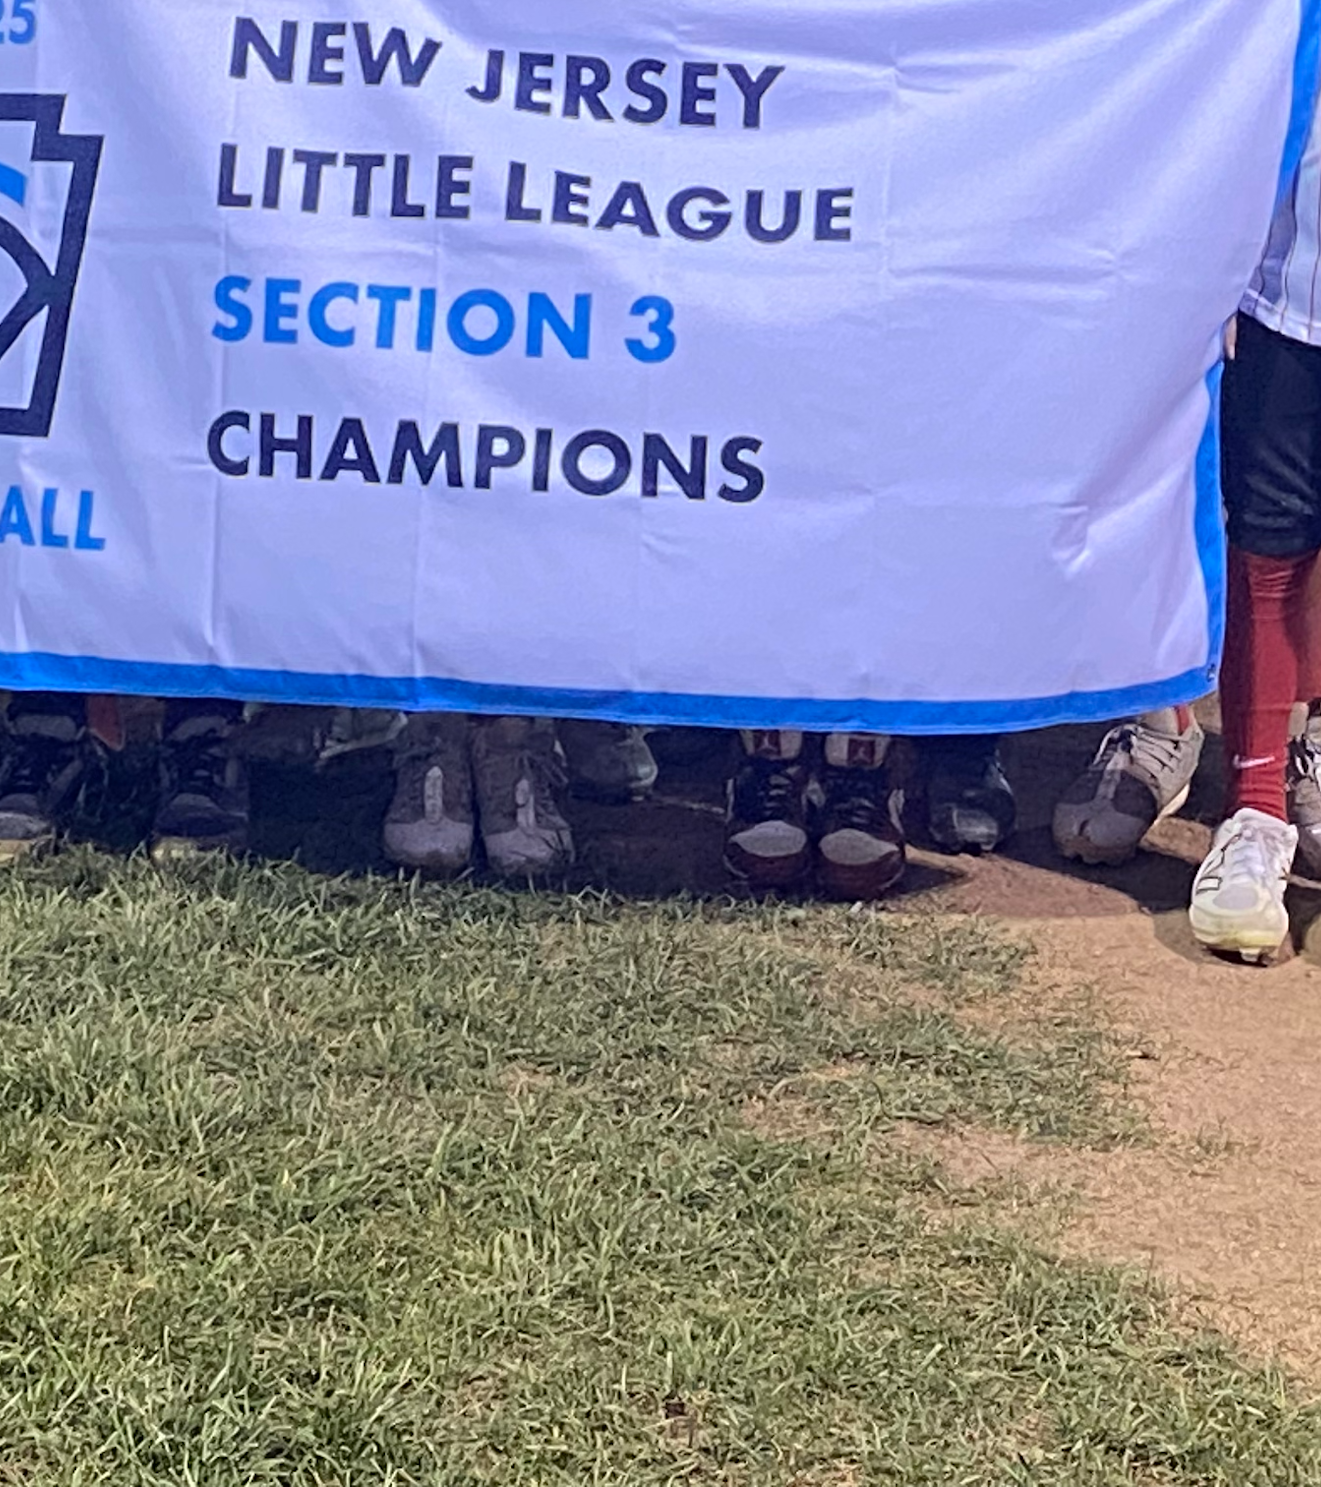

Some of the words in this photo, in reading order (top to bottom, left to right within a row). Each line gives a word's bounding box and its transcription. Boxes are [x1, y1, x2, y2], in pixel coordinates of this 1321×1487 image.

[229, 16, 443, 87] NEW
[465, 48, 786, 129] JERSEY
[216, 142, 474, 220] LITTLE
[505, 160, 855, 243] LEAGUE
[210, 274, 593, 360] SECTION
[624, 295, 678, 363] 3
[206, 410, 766, 503] CHAMPIONS
